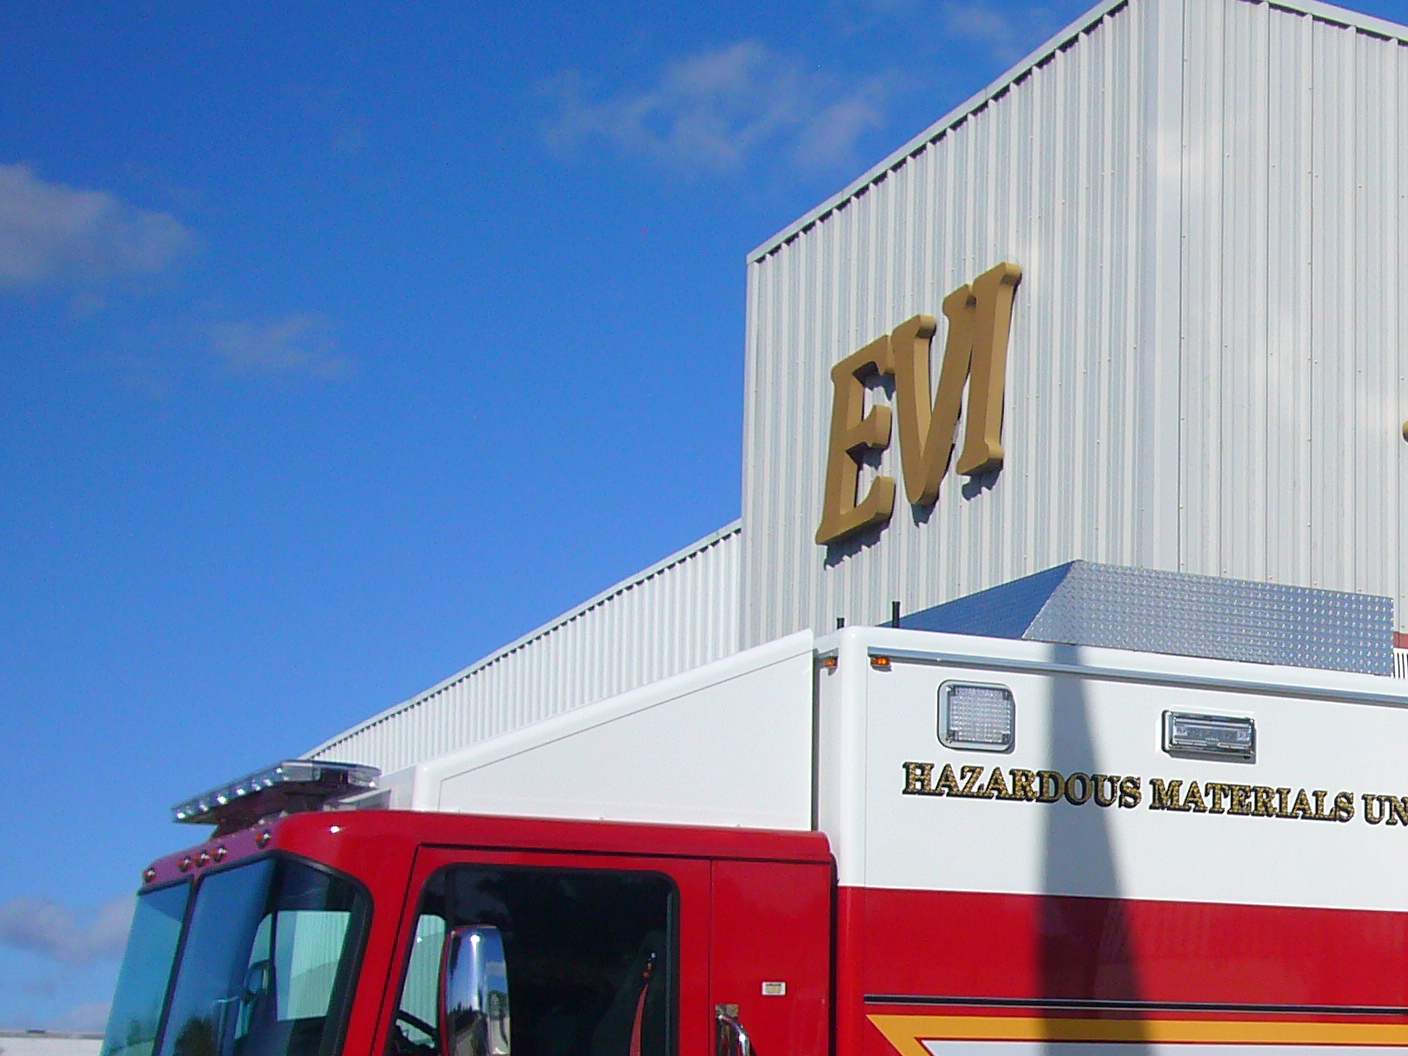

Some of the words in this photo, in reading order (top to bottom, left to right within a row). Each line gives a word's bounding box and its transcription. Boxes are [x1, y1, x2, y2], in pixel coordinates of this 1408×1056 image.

[815, 261, 1022, 545] EVI
[902, 761, 1142, 809] HAZARDOUS
[1149, 778, 1355, 823] MATERIALS
